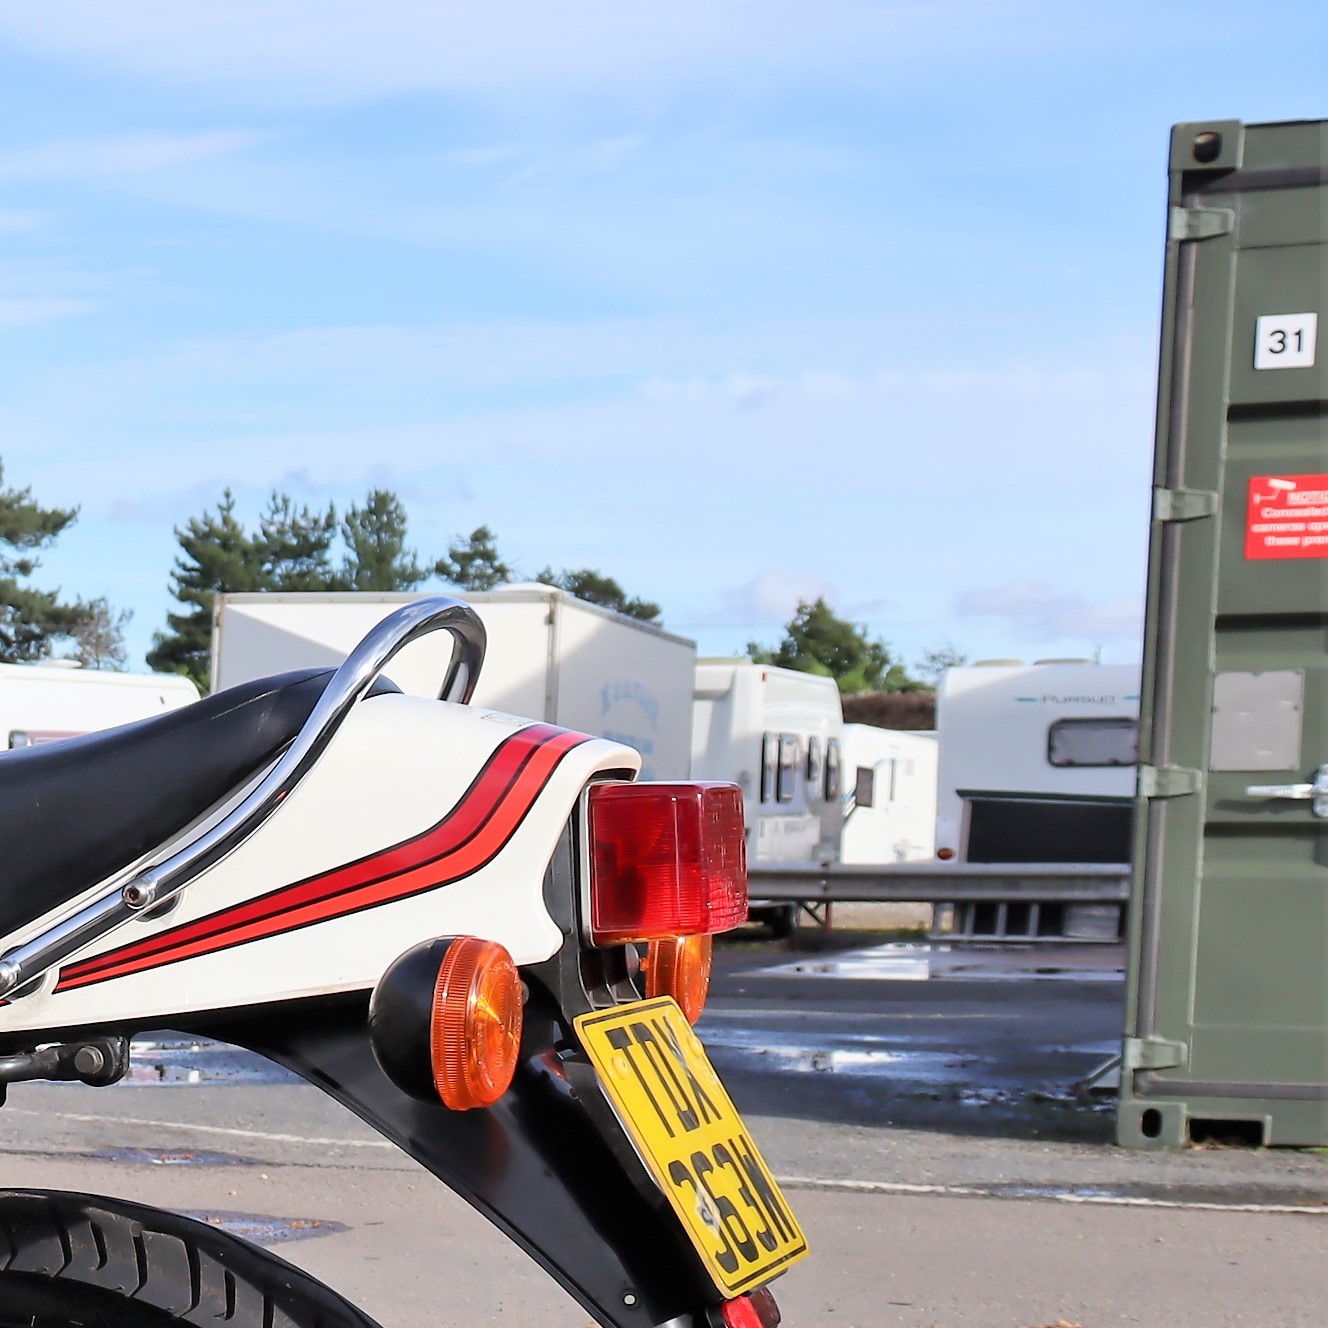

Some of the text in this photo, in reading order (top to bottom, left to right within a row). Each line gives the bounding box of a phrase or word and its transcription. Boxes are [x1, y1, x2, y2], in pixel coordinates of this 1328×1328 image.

[1269, 329, 1304, 355] 31
[605, 1016, 722, 1138] TDX
[668, 1134, 797, 1273] 363W
